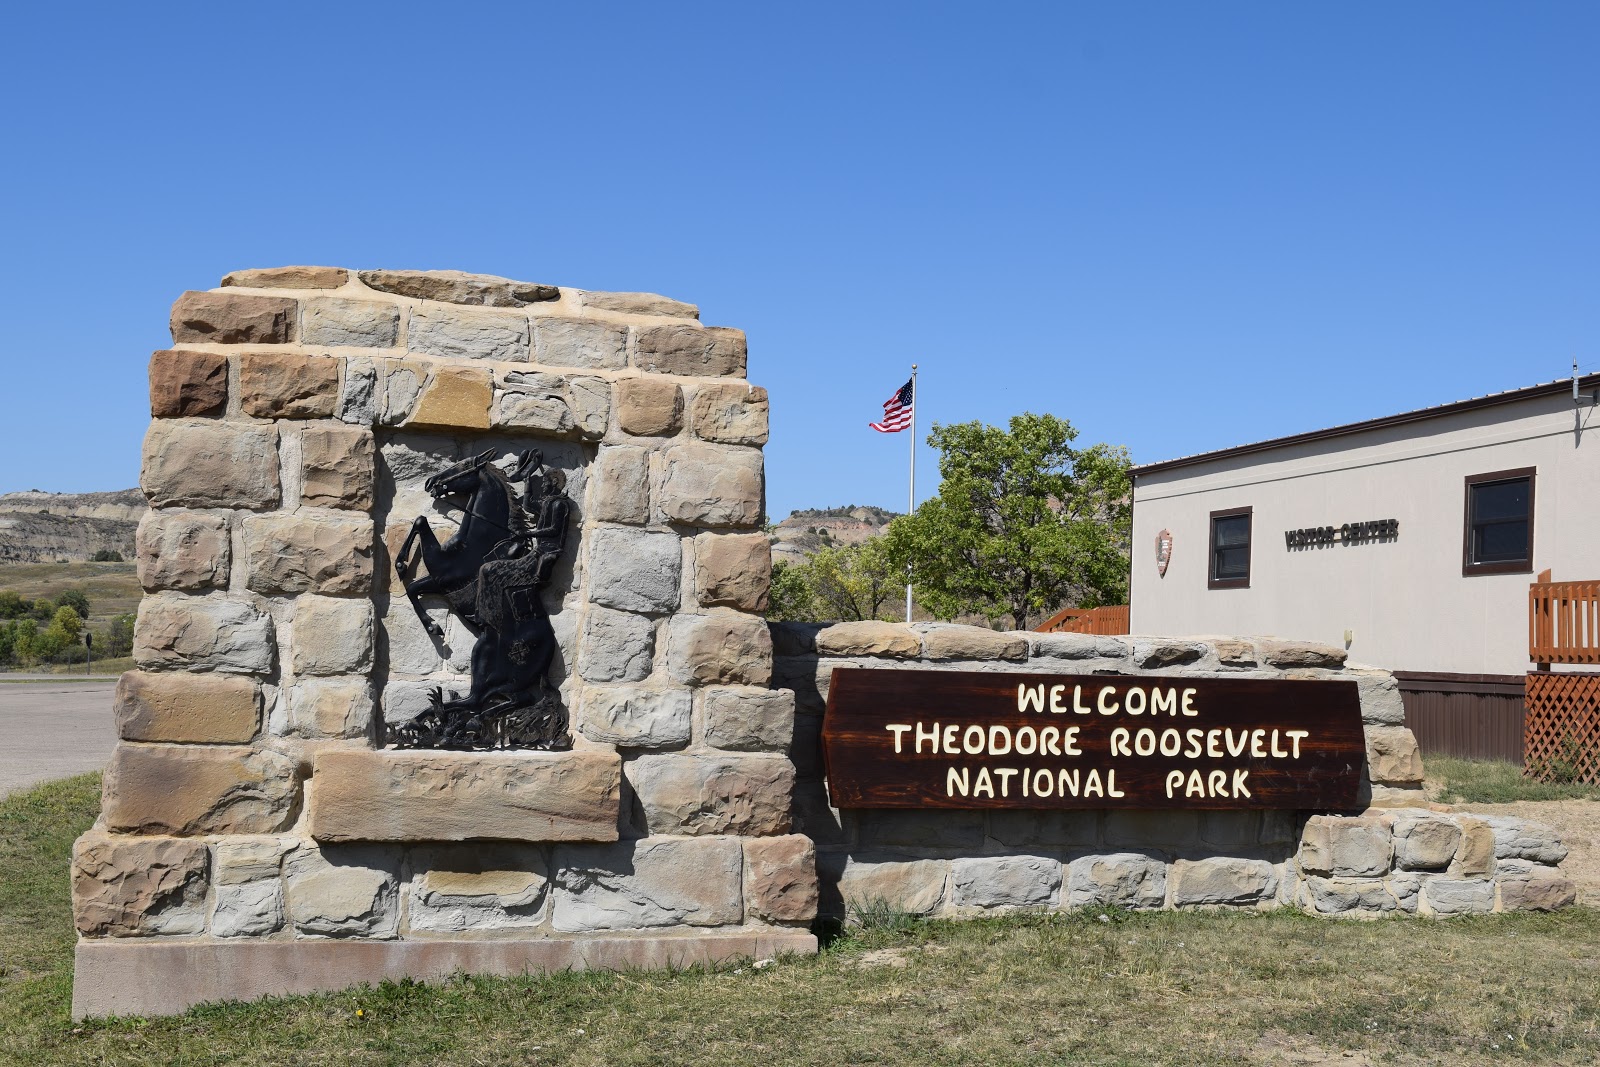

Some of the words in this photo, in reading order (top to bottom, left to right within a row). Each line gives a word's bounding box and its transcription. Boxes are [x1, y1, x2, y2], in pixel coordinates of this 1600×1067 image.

[1285, 526, 1335, 547] VISITOR
[1341, 519, 1397, 541] CENTER
[1017, 683, 1199, 717] WELCOME
[885, 721, 1083, 756] THEODORE
[1110, 727, 1310, 760] ROOSEVELT
[946, 766, 1125, 799] NATIONAL
[1165, 768, 1252, 799] PARK
